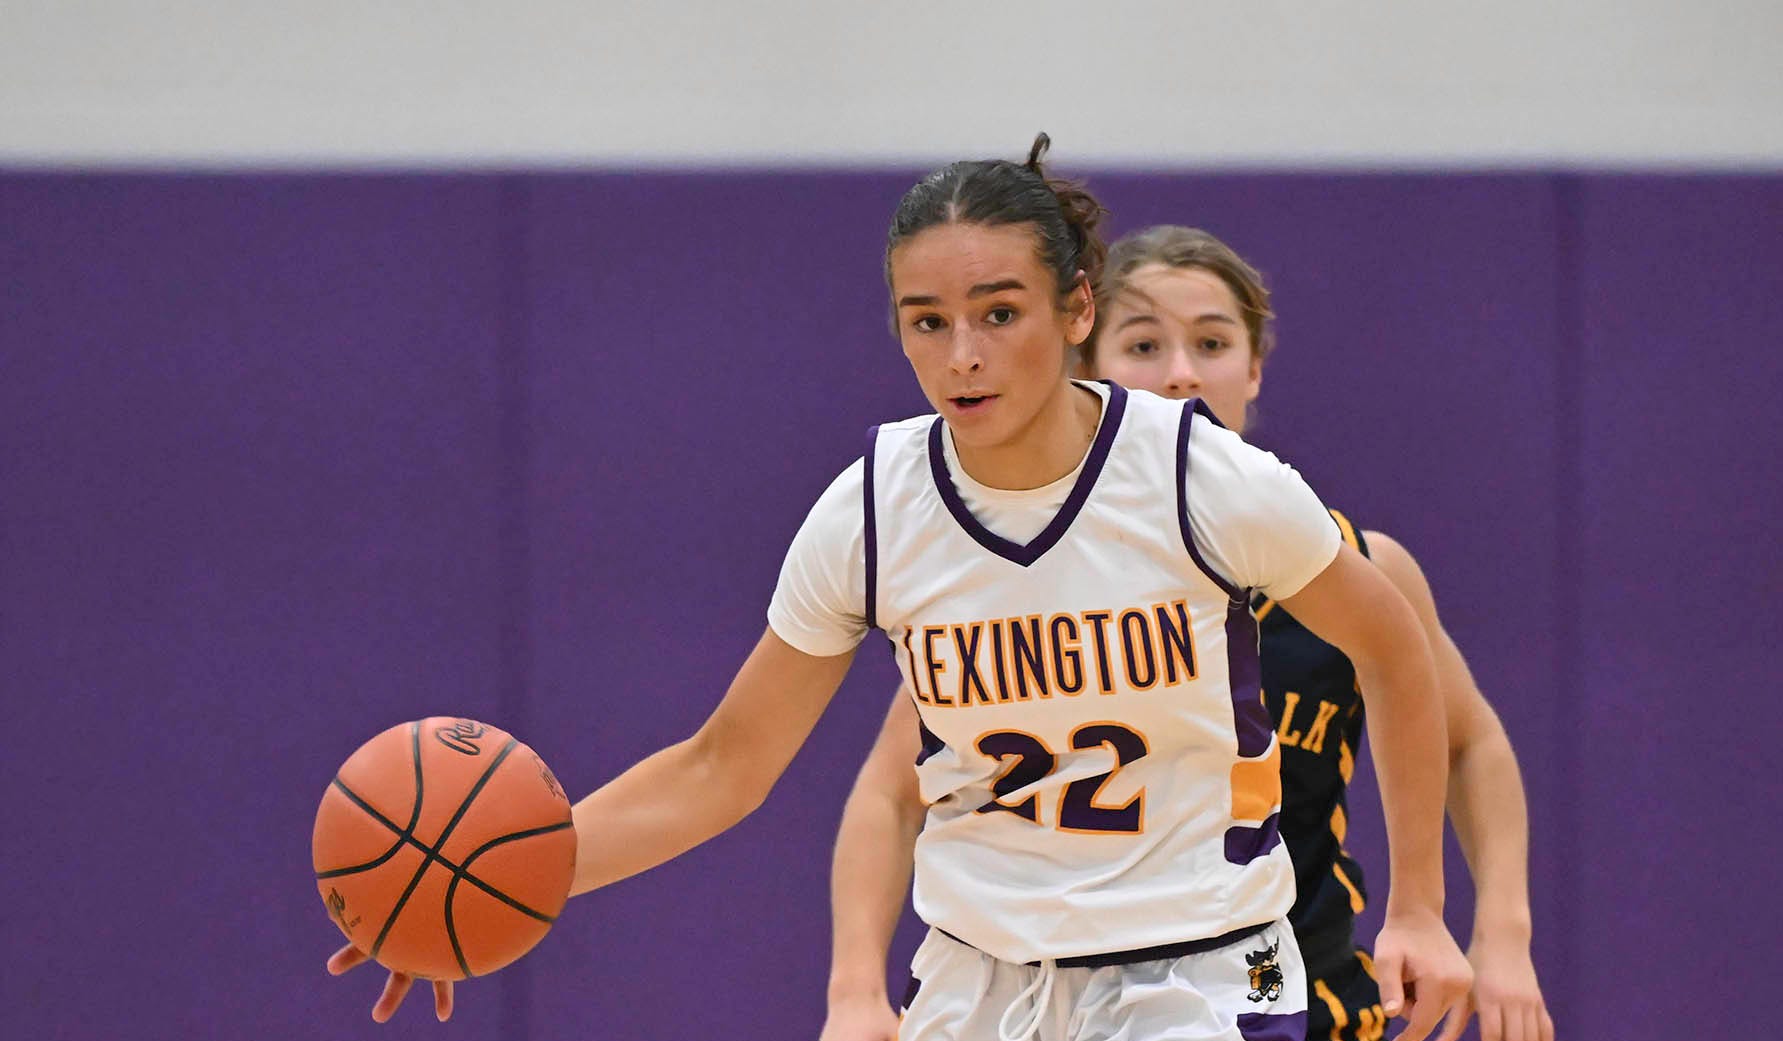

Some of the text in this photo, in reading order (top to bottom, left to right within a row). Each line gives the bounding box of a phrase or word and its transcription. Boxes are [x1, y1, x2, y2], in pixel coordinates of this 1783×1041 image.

[904, 599, 1199, 708] LEXINGTON
[1261, 687, 1339, 754] LK
[973, 720, 1149, 835] 22
